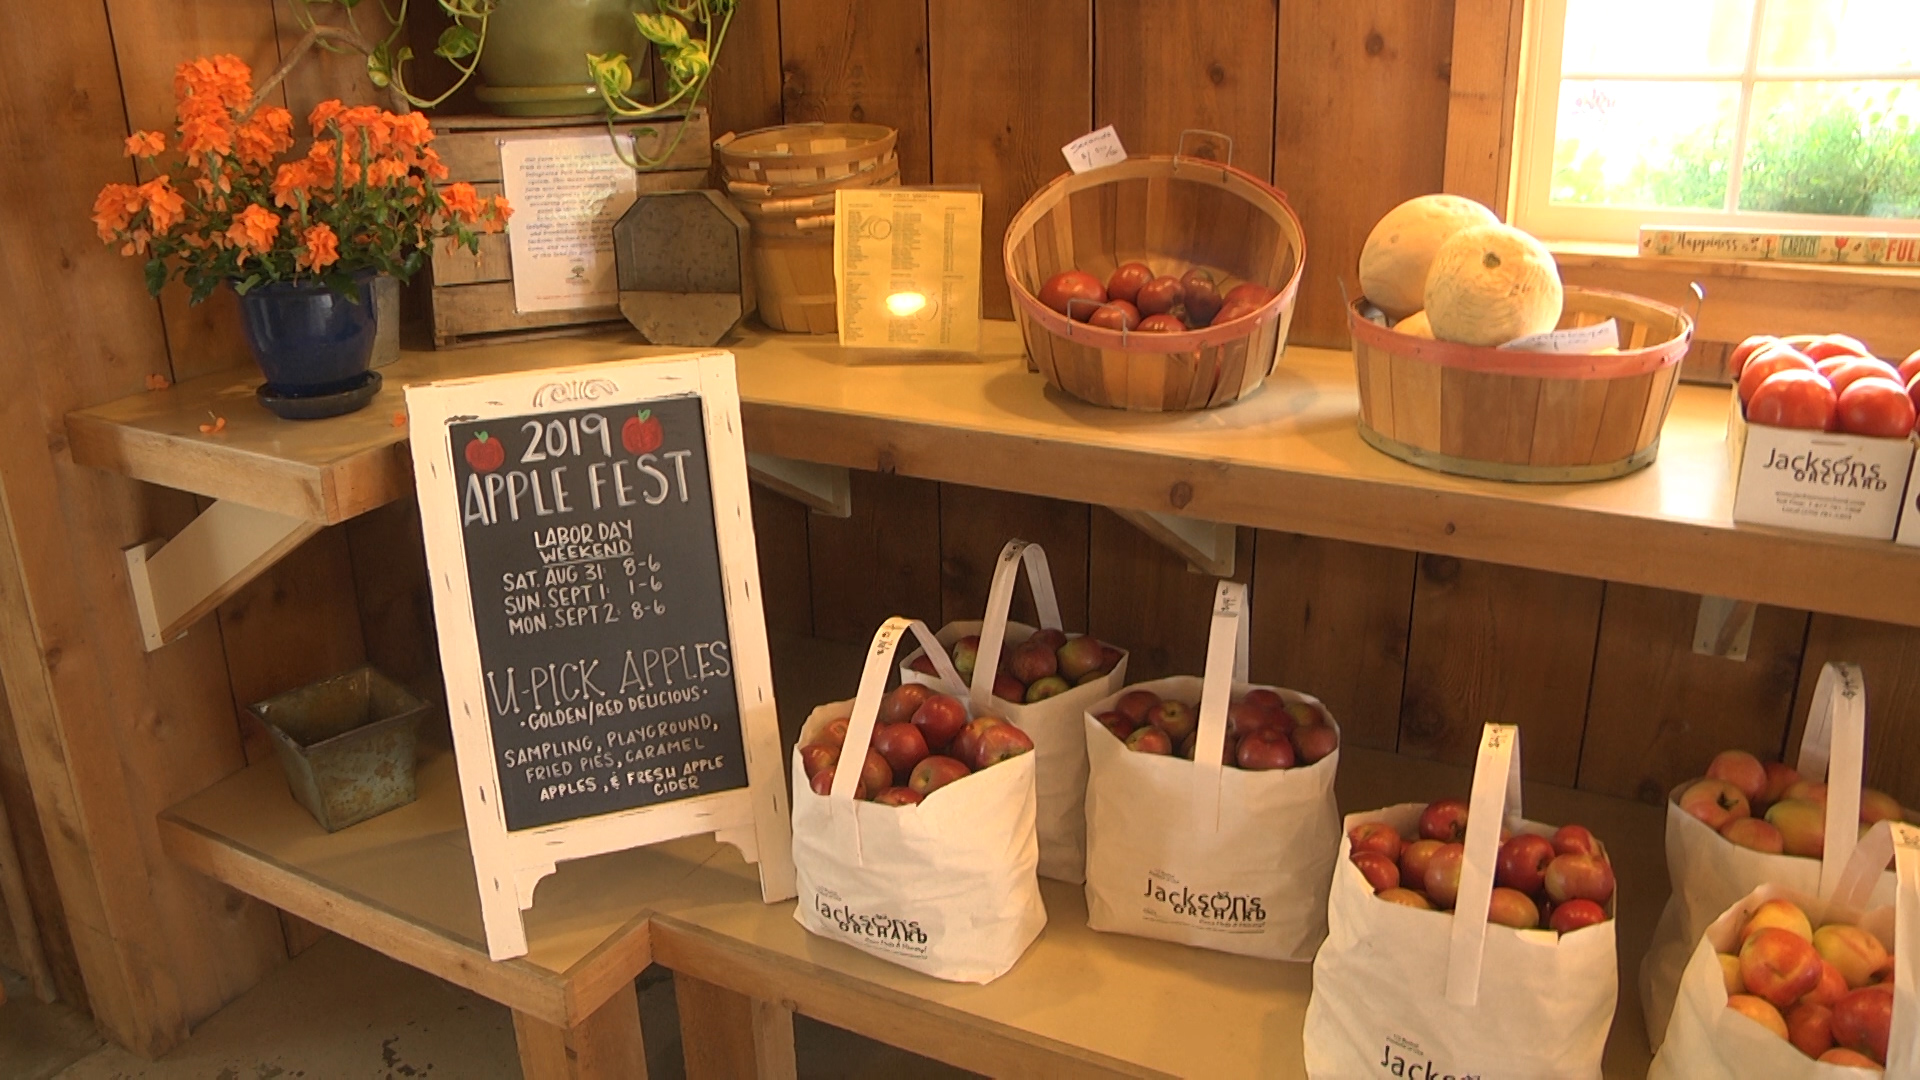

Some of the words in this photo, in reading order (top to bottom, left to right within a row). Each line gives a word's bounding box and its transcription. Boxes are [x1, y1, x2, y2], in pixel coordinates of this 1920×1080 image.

[1677, 232, 1738, 253] Happiness
[1885, 238, 1920, 262] FUL
[520, 413, 612, 464] 2019
[464, 466, 574, 527] APPLE
[588, 450, 692, 511] FEST
[1794, 469, 1887, 492] ORCHARD
[534, 523, 594, 550] LABOR
[598, 519, 632, 541] DAY
[540, 539, 632, 564] WEEKEND
[545, 564, 578, 586] AUG
[622, 553, 661, 576] 8-6
[549, 584, 593, 608] SEPT
[629, 575, 663, 596] 1-6
[555, 605, 599, 628] SEPT
[631, 599, 666, 620] 8-6
[487, 658, 606, 716] U-PICK
[619, 640, 731, 694] APPLES
[504, 735, 602, 768] SAMPLING,
[607, 713, 719, 748] PLAYGROUND,
[525, 761, 573, 784] FRIED
[580, 752, 623, 773] PIES,
[625, 738, 706, 763] CARAMEL
[626, 767, 676, 786] FRESH
[683, 755, 725, 775] APPLE
[654, 776, 700, 796] CIDER
[1173, 903, 1266, 921] ORCHARD
